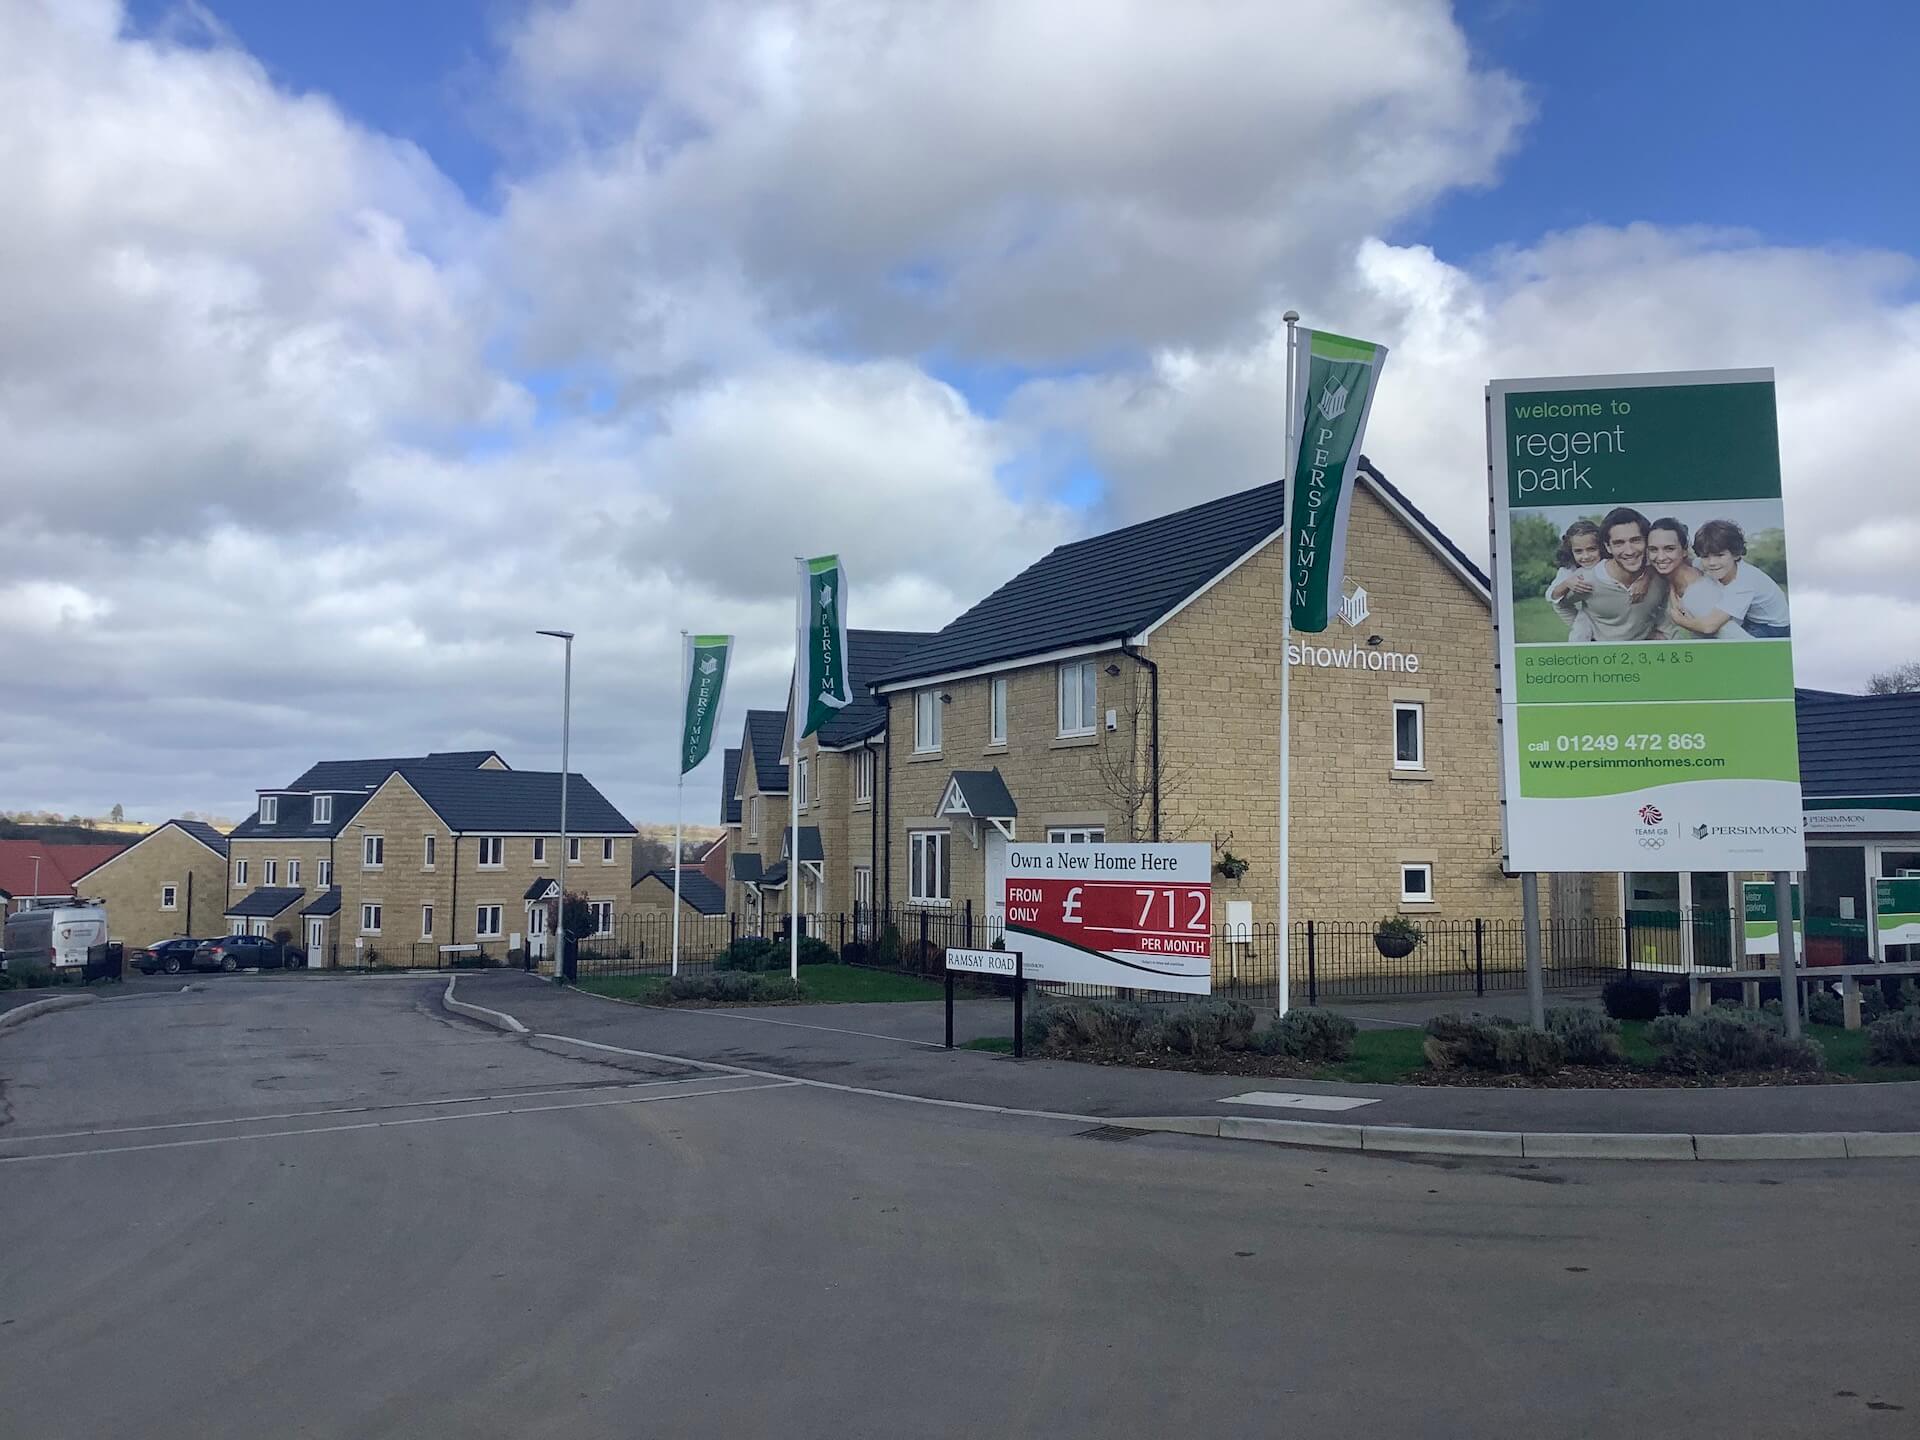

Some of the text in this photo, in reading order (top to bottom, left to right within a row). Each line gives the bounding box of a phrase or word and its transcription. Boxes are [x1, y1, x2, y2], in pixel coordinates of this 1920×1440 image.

[1514, 399, 1631, 419] welcome to
[1515, 424, 1626, 463] regent
[1517, 460, 1592, 499] park
[1288, 639, 1419, 673] showhome
[1525, 655, 1534, 667] a
[1538, 653, 1599, 667] selection
[1603, 652, 1617, 666] of
[1656, 651, 1666, 664] 4
[1670, 651, 1681, 664] &
[1684, 651, 1694, 664] 5
[1526, 671, 1641, 685] bedroom homes
[1528, 733, 1706, 752] call 01249 472 863
[1528, 756, 1725, 771] www.persimmonhomes.com
[1634, 828, 1669, 836] TEAM GB
[1711, 825, 1798, 836] PERSIMMON
[1011, 852, 1178, 871] Own a New Home Here
[1009, 887, 1043, 903] FROM
[1009, 907, 1039, 922] ONLY
[1061, 887, 1207, 930] £ 712
[1141, 937, 1205, 953] PER MONTH
[948, 953, 984, 968] RAMSAY
[988, 954, 1015, 971] ROAD
